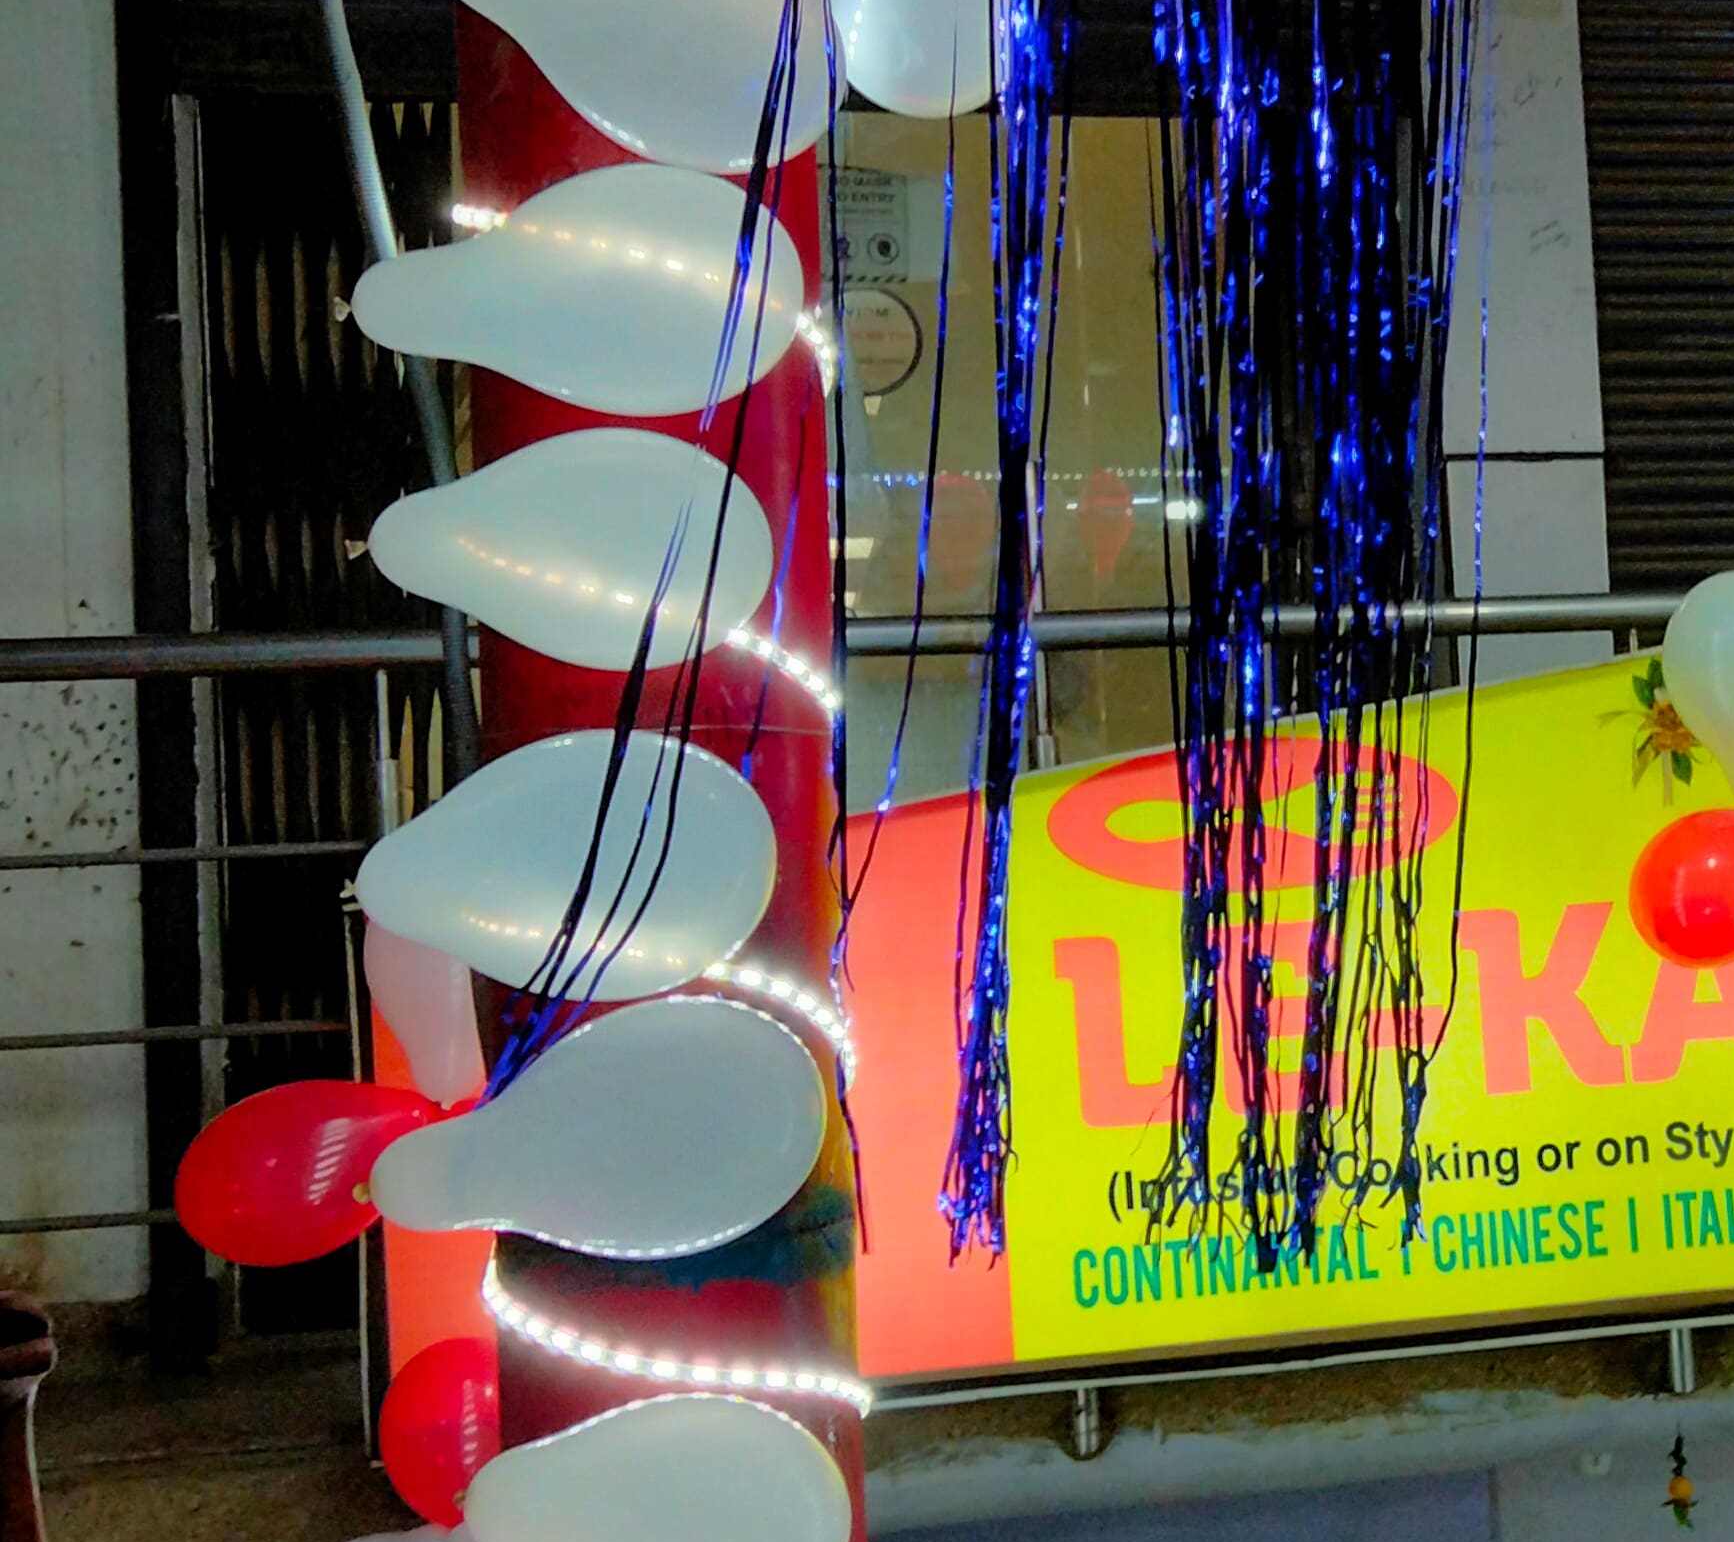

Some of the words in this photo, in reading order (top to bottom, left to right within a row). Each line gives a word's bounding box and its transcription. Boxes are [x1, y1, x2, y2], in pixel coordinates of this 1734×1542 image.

[852, 192, 895, 203] ENTRY
[1329, 1142, 1520, 1190] Coking
[1537, 1140, 1580, 1172] or
[1597, 1135, 1649, 1168] on
[1432, 1200, 1608, 1273] CHINESE
